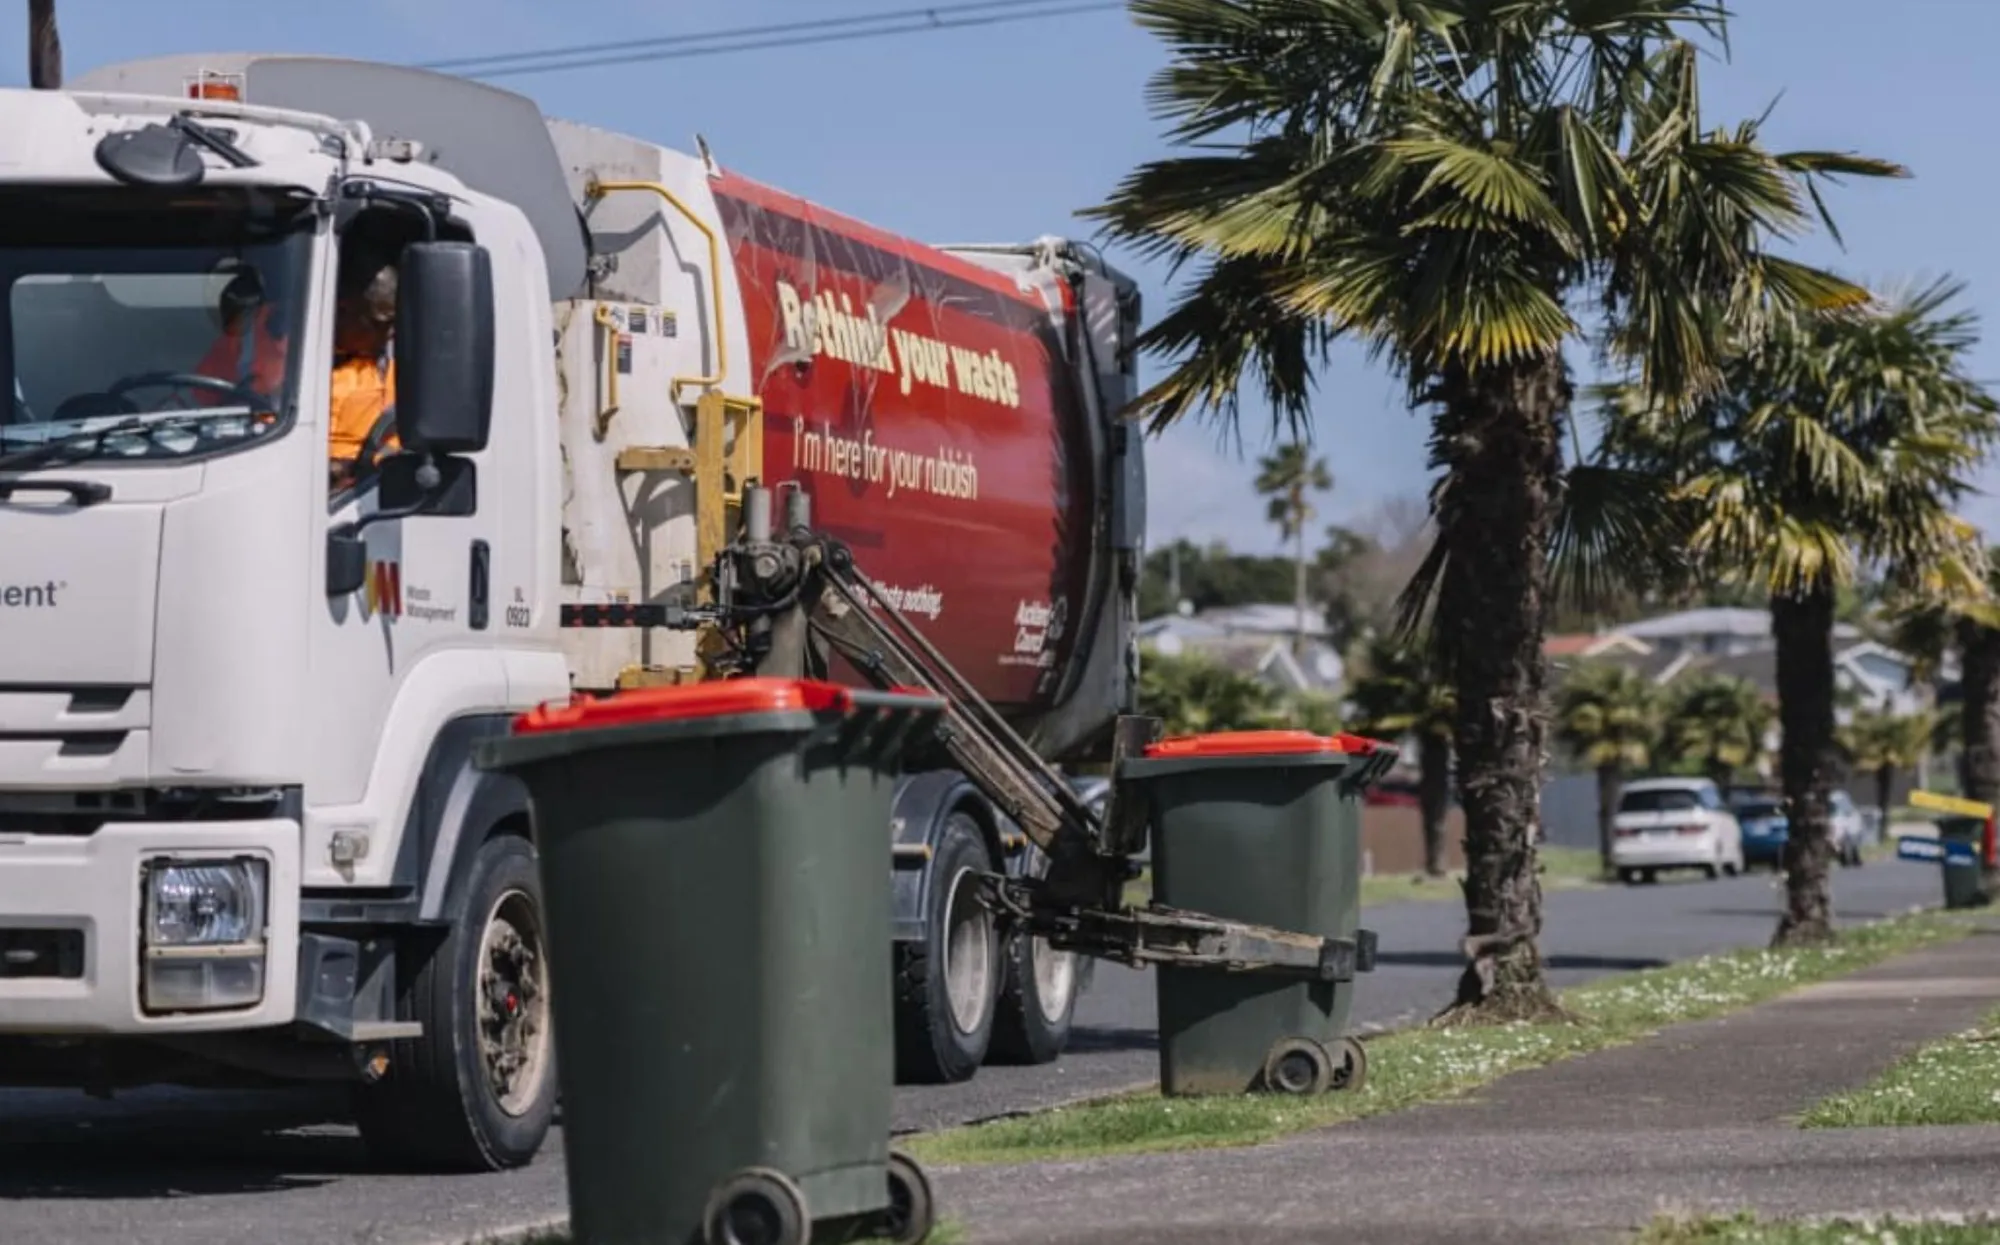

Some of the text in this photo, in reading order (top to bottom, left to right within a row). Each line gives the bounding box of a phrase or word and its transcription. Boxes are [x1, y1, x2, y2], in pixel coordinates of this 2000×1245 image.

[777, 281, 1019, 409] Rethink your waste
[793, 413, 978, 500] I'm here for your rubbish
[0, 580, 57, 607] ent
[506, 605, 530, 628] 0923
